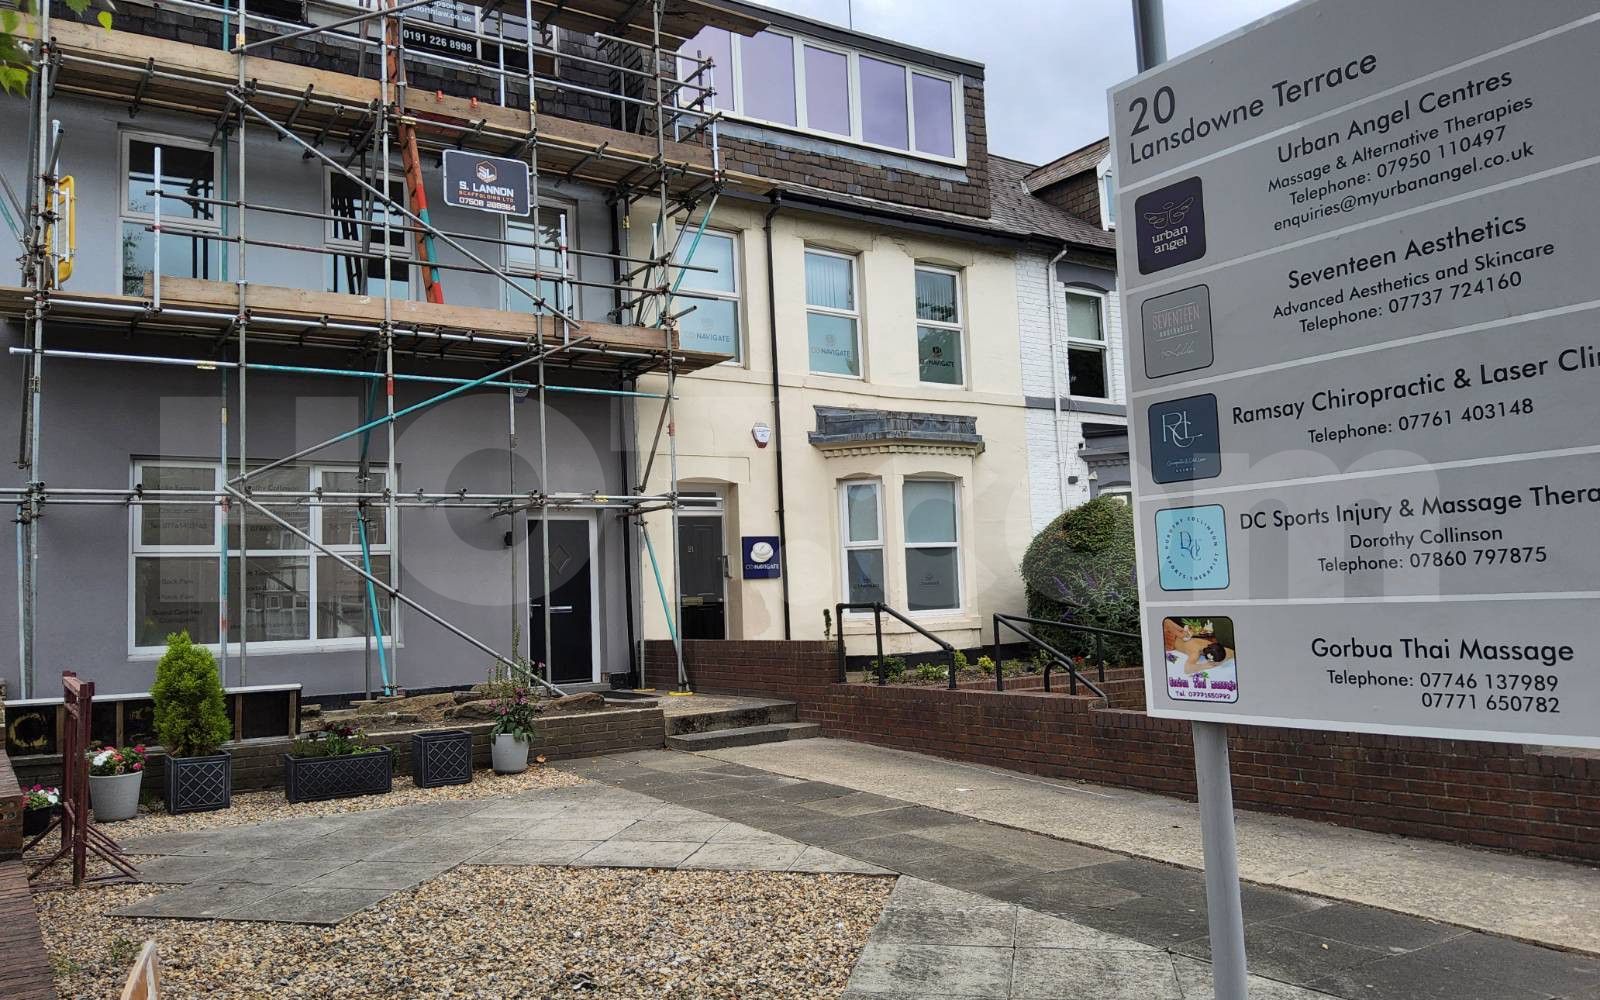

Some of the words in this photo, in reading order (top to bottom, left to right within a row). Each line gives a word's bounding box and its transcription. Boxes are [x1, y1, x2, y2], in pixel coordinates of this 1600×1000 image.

[404, 29, 426, 42] 0191
[430, 35, 446, 46] 226
[450, 40, 472, 52] 8998
[1128, 85, 1175, 135] 20
[1130, 100, 1264, 164] Lansdowne
[1272, 53, 1377, 106] Terrace
[1278, 132, 1339, 164] Urban
[1347, 101, 1411, 141] Angel
[1418, 69, 1513, 113] Centres
[1268, 163, 1331, 192] Massage
[1336, 154, 1348, 169] &
[1352, 126, 1439, 165] Alternative
[1445, 95, 1534, 135] Therapies
[1289, 170, 1371, 206] Telephone:
[1377, 150, 1431, 178] 07950
[1439, 126, 1507, 159] 110497
[473, 183, 514, 197] LANNON
[1274, 142, 1534, 231] enquiries@myurbanangel.co.uk
[1152, 226, 1188, 244] urban
[1154, 235, 1187, 254] angel
[1288, 250, 1396, 289] Seventeen
[1405, 214, 1527, 260] Aesthetics
[1273, 290, 1344, 319] Advanced
[1349, 272, 1430, 303] Aesthetics
[1436, 260, 1469, 281] and
[1474, 241, 1555, 272] Skincare
[1299, 306, 1382, 333] Telephone:
[1388, 289, 1443, 314] 07737
[1450, 271, 1523, 301] 724160
[1232, 398, 1305, 425] Ramsay
[1311, 372, 1446, 411] Chiropractic
[1453, 368, 1471, 389] &
[1480, 359, 1548, 385] Laser
[1558, 346, 1600, 371] Cli
[1308, 422, 1392, 444] Telephone:
[1398, 410, 1453, 431] 07761
[1460, 399, 1534, 423] 403148
[1240, 511, 1266, 530] DC
[1273, 507, 1330, 531] Sports
[1336, 502, 1392, 526] Injury
[1399, 499, 1414, 516] &
[1421, 490, 1522, 517] Massage
[1317, 555, 1403, 575] Telephone:
[1409, 550, 1466, 568] 07860
[1473, 546, 1546, 566] 797875
[1349, 531, 1415, 550] Dorothy
[1420, 526, 1503, 544] Collinson
[1311, 638, 1392, 659] Gorbua
[1400, 637, 1450, 660] Thai
[1459, 639, 1573, 666] Massage
[1327, 670, 1413, 690] Telephone:
[1420, 672, 1477, 690] 07746
[1485, 673, 1558, 692] 137989
[1421, 693, 1476, 709] 07771
[1486, 694, 1560, 713] 650782
